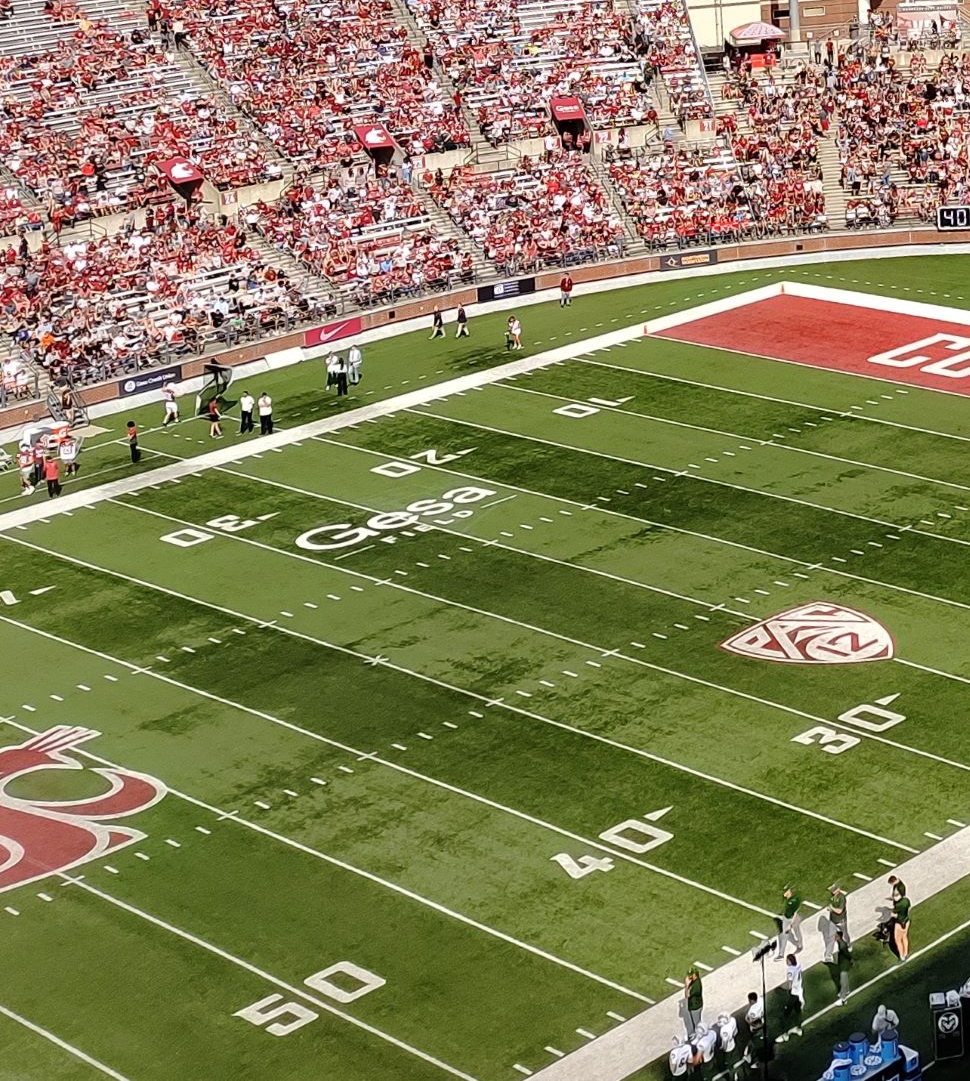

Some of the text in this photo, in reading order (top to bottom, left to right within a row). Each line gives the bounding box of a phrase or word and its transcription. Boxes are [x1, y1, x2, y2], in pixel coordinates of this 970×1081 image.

[944, 209, 967, 227] 40
[295, 486, 498, 551] Gesa
[379, 510, 474, 544] FIELD
[790, 703, 907, 755] 30
[549, 819, 675, 880] 40
[231, 960, 387, 1037] 50
